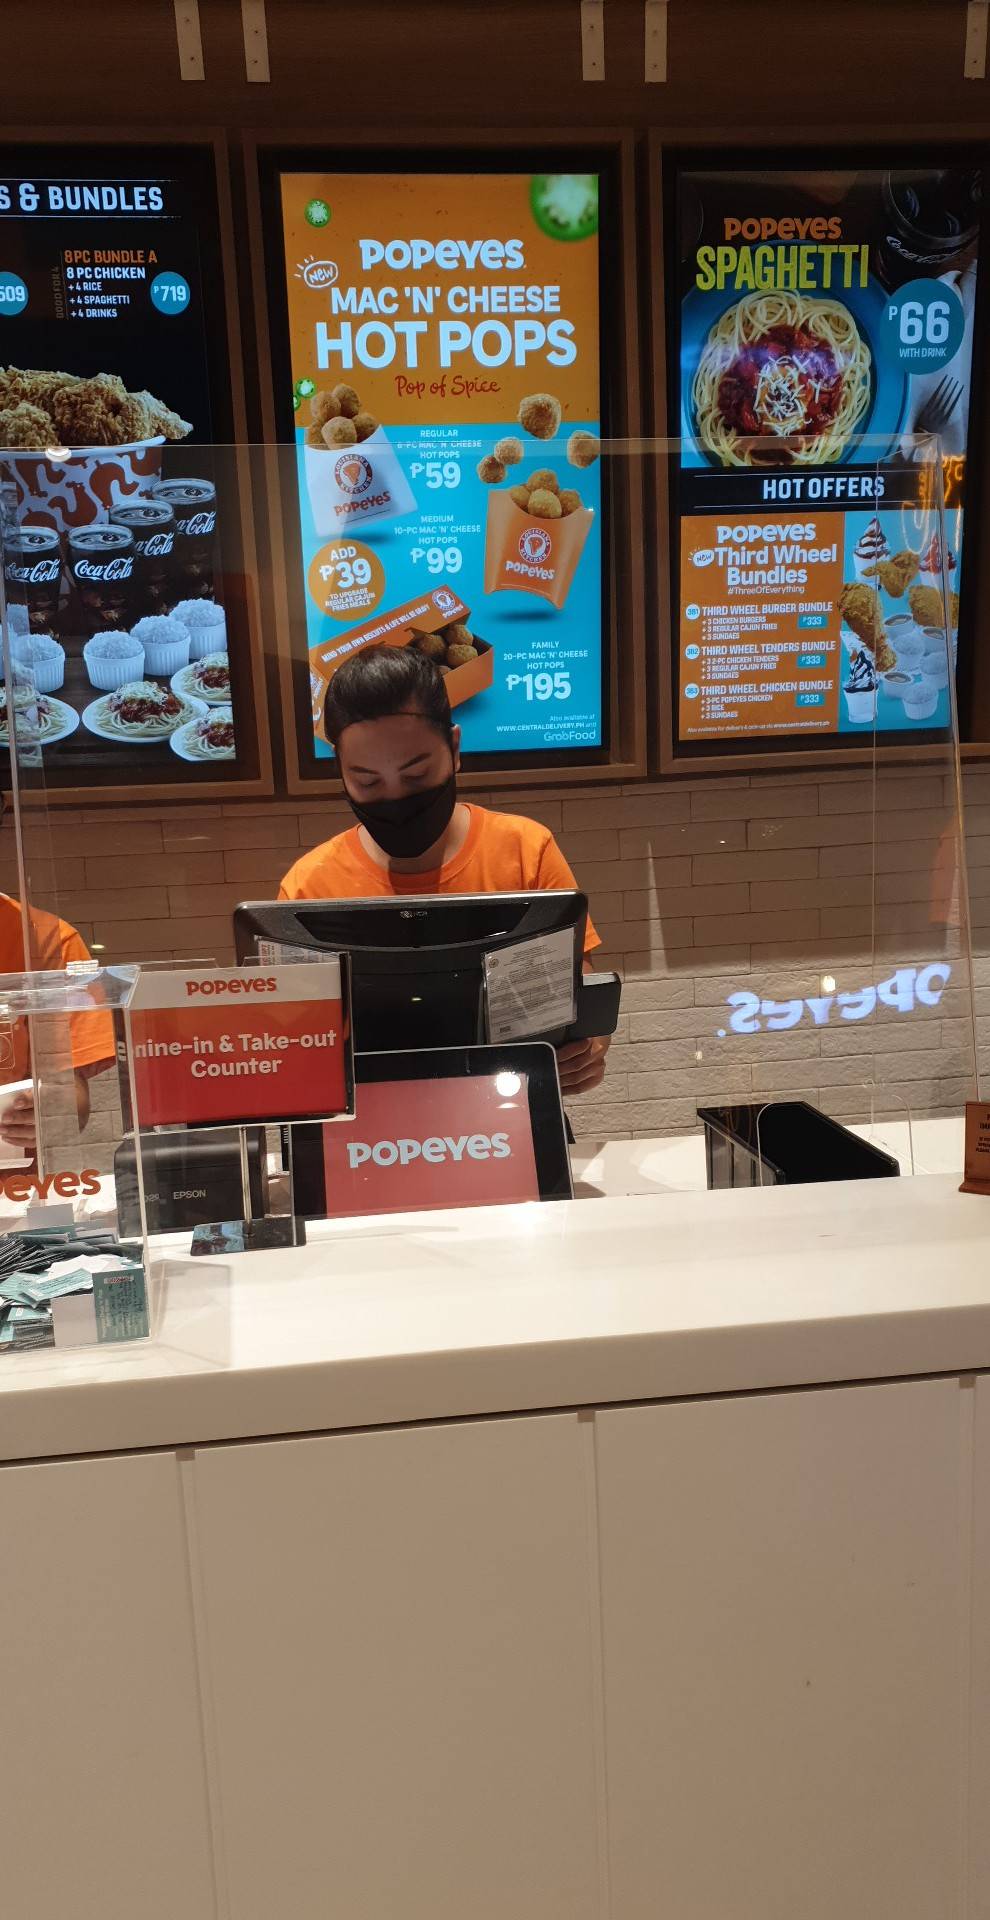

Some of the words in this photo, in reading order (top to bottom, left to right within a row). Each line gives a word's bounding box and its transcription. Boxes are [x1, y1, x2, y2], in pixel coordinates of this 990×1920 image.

[19, 183, 40, 211] &
[48, 186, 163, 210] BUNDLES
[94, 250, 145, 263] BUNDLE
[148, 251, 158, 263] A
[66, 267, 75, 279] 8
[77, 267, 92, 279] PC
[94, 267, 146, 279] CHICKEN
[695, 244, 870, 291] SPAGHETTI
[83, 282, 102, 291] RICE
[84, 295, 130, 304] SPAGHETTI
[331, 287, 399, 314] MAC
[404, 286, 440, 313] 'N'
[447, 286, 560, 313] CHEESE
[86, 309, 118, 318] DRINKS
[315, 320, 428, 369] HOT
[439, 319, 577, 367] POPS
[900, 348, 920, 358] WITH
[921, 347, 947, 357] DRINK
[395, 375, 425, 398] Pop
[431, 375, 447, 397] of
[452, 375, 501, 395] Spice
[420, 429, 458, 438] REGULAR
[420, 451, 436, 459] HOT
[763, 478, 804, 500] HOT
[808, 476, 885, 498] OFFERS
[421, 515, 454, 523] MEDIUM
[394, 527, 418, 535] 10-PC
[419, 526, 437, 534] MAC
[450, 525, 481, 533] CHEESE
[331, 546, 357, 561] ADD
[714, 545, 769, 567] Third
[773, 544, 837, 564] Wheel
[74, 557, 136, 581] Coca-Cola
[727, 565, 808, 586] Bundles
[727, 585, 805, 595] #ThreeOfEverything
[702, 606, 728, 616] THIRD
[730, 605, 761, 615] WHEEL
[761, 603, 797, 614] BURGER
[798, 602, 833, 612] BUNDLE
[712, 617, 739, 625] CHICKEN
[531, 641, 560, 649] FAMILY
[701, 646, 728, 656] THIRD
[729, 644, 760, 654] WHEEL
[760, 642, 800, 653] TENDERS
[801, 641, 836, 651] BUNDLE
[558, 650, 588, 658] CHEESE
[726, 656, 752, 664] CHICKEN
[527, 662, 543, 670] HOT
[544, 661, 565, 669] POPS
[740, 663, 760, 671] CAJUN
[700, 686, 727, 695] THIRD
[728, 684, 759, 694] WHEEL
[760, 682, 798, 693] CHICKEN
[799, 680, 834, 690] BUNDLE
[543, 728, 596, 741] GrabFood
[219, 1034, 234, 1053] &
[238, 1029, 337, 1052] Take-out
[190, 1057, 283, 1078] Counter
[173, 1190, 206, 1200] EPSON
